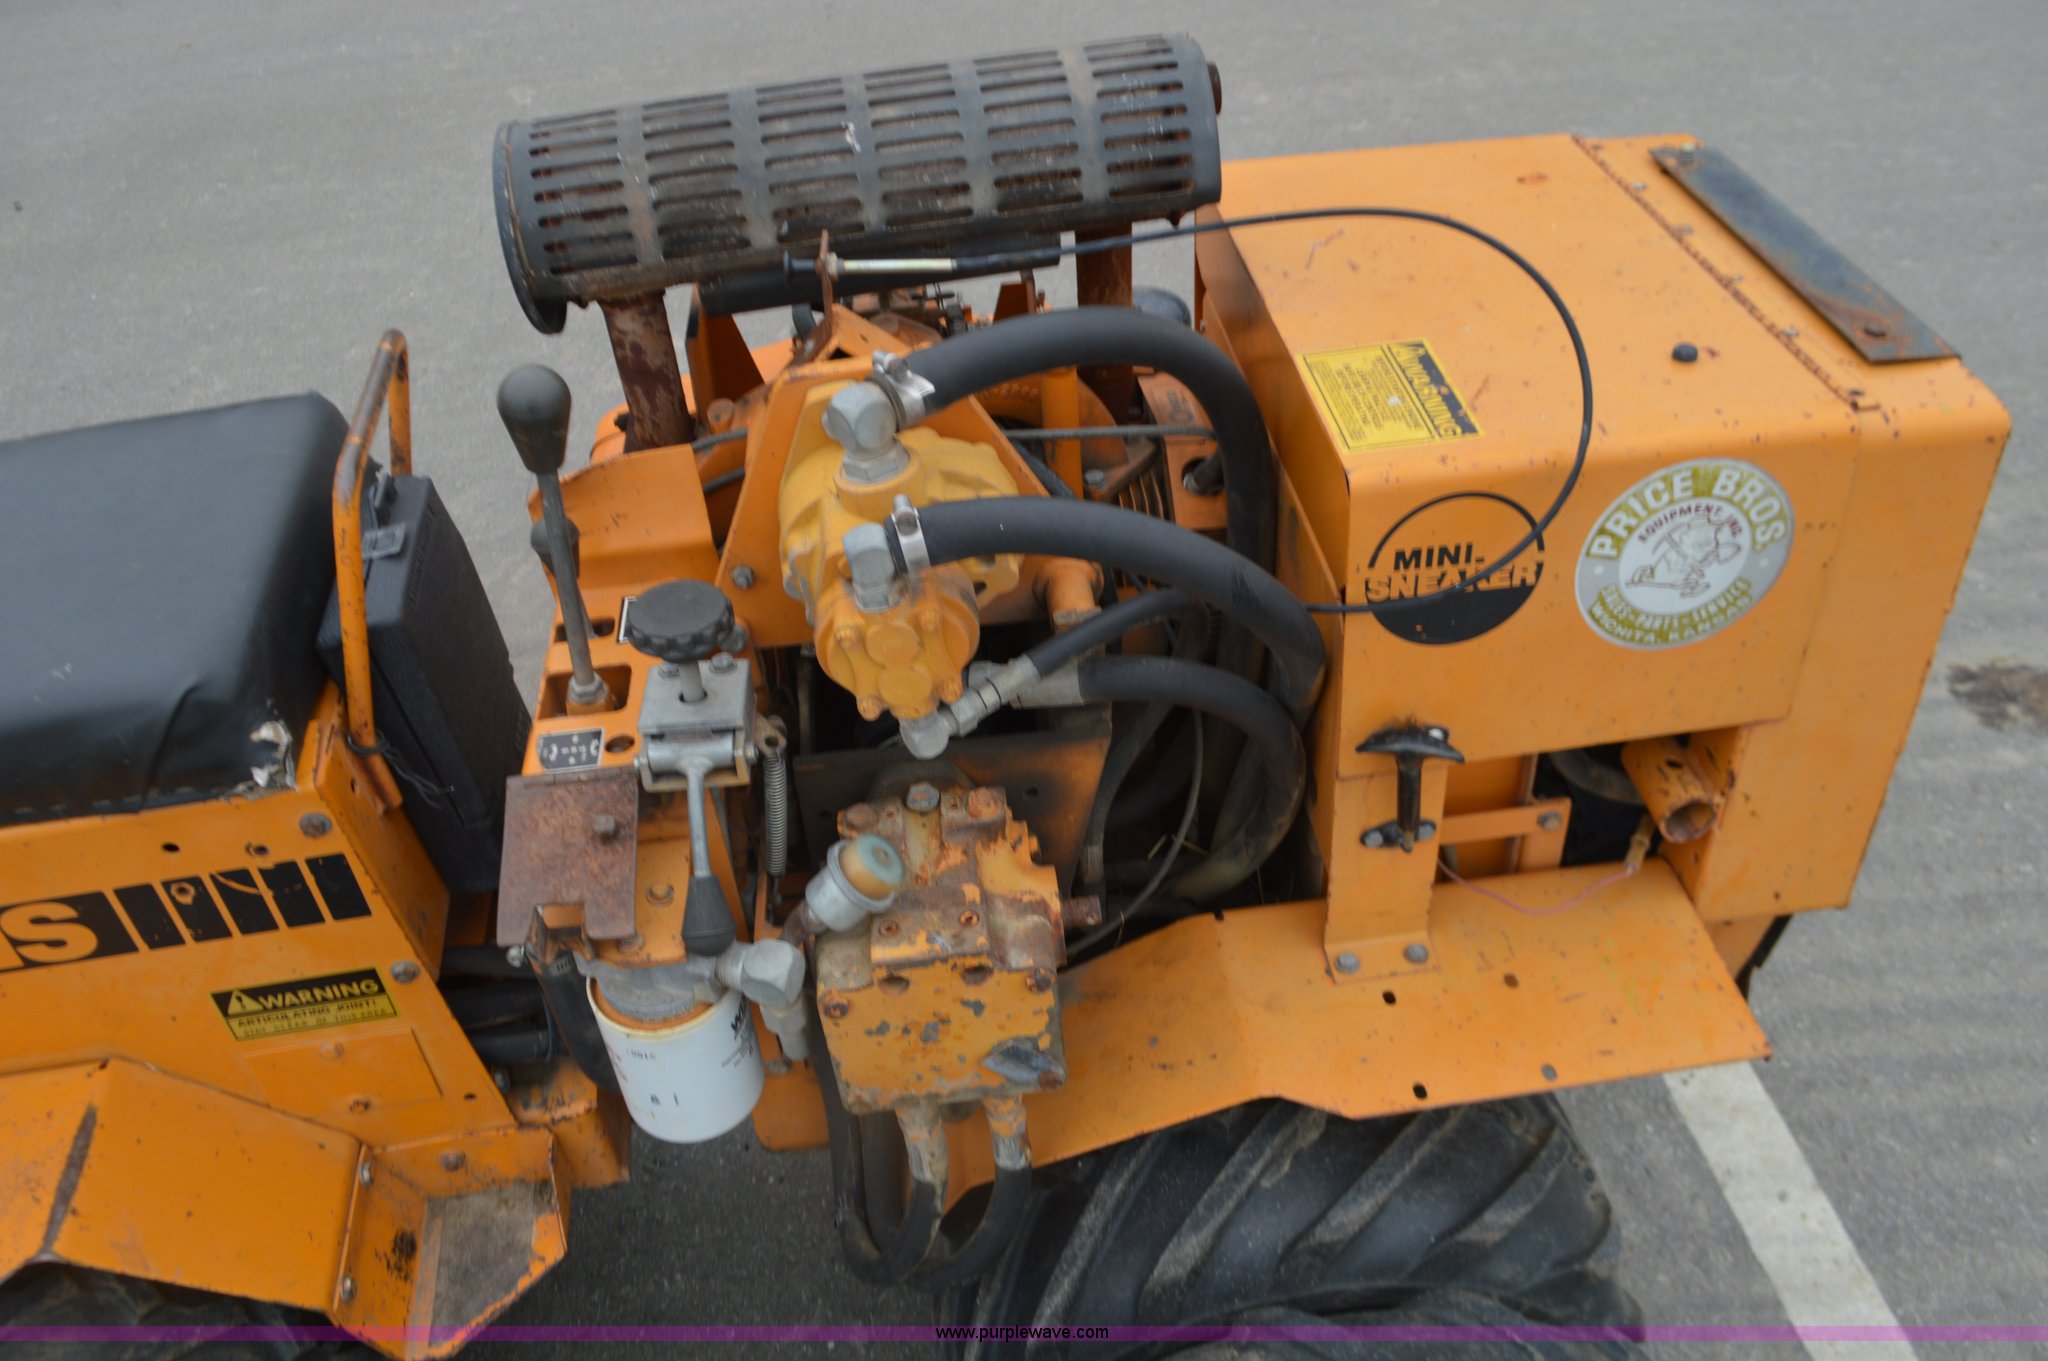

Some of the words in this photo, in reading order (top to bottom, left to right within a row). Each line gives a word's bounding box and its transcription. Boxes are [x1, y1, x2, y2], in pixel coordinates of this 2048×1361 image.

[1588, 470, 1693, 557] PRICE
[1394, 542, 1485, 571] MINI-
[258, 979, 379, 1010] WARNING
